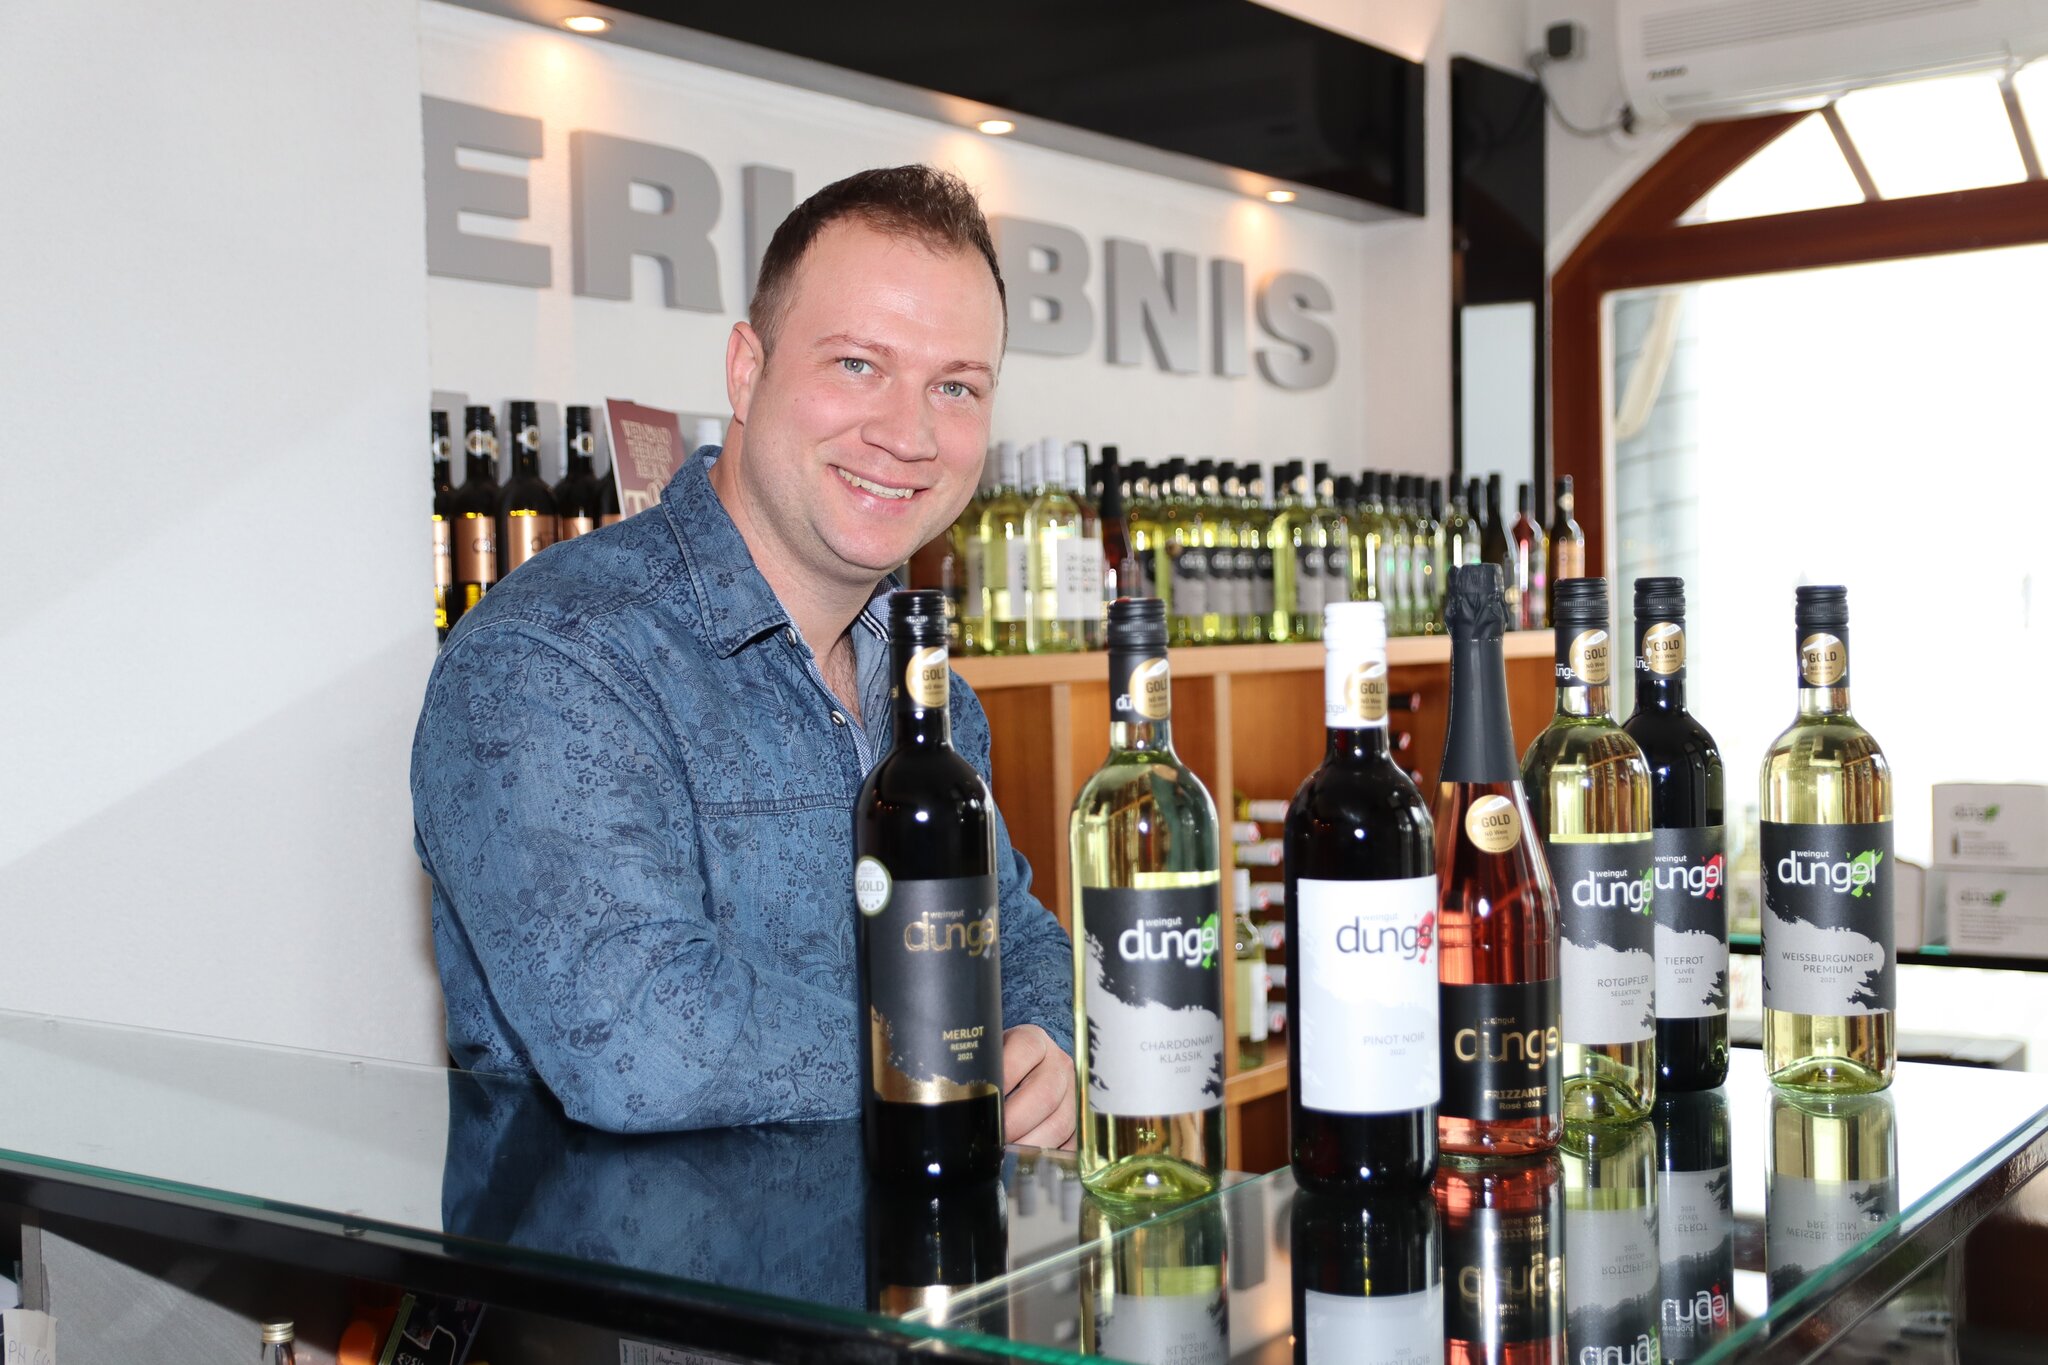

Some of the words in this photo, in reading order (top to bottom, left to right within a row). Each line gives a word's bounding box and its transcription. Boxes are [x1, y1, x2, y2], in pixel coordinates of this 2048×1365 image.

[1653, 640, 1680, 651] GOLD
[1584, 647, 1607, 660] GOLD
[1809, 651, 1837, 663] GOLD
[1481, 814, 1511, 828] GOLD
[1655, 854, 1687, 863] weingut
[1796, 850, 1829, 858] weingut
[1596, 869, 1628, 878] weingut
[1654, 856, 1723, 896] ungel
[1777, 850, 1876, 893] dungel
[857, 879, 885, 892] GOLD
[930, 909, 964, 919] weingut
[1145, 916, 1182, 928] weingut
[1664, 956, 1704, 965] TIEFROT
[1782, 952, 1874, 963] WEISSBURGUNDER
[1803, 964, 1853, 974] PREMIUM
[1597, 974, 1649, 987] ROTGIPFLER
[942, 1026, 984, 1041] MERLOT
[1363, 1034, 1399, 1046] PINOT
[1402, 1032, 1426, 1044] NOIR
[950, 1040, 979, 1051] RESERVE
[1140, 1035, 1214, 1052] CHARDONNAY
[1160, 1052, 1203, 1064] KLASSIK
[1484, 1086, 1548, 1100] FRIZZANTE
[1499, 1101, 1521, 1110] Rosé
